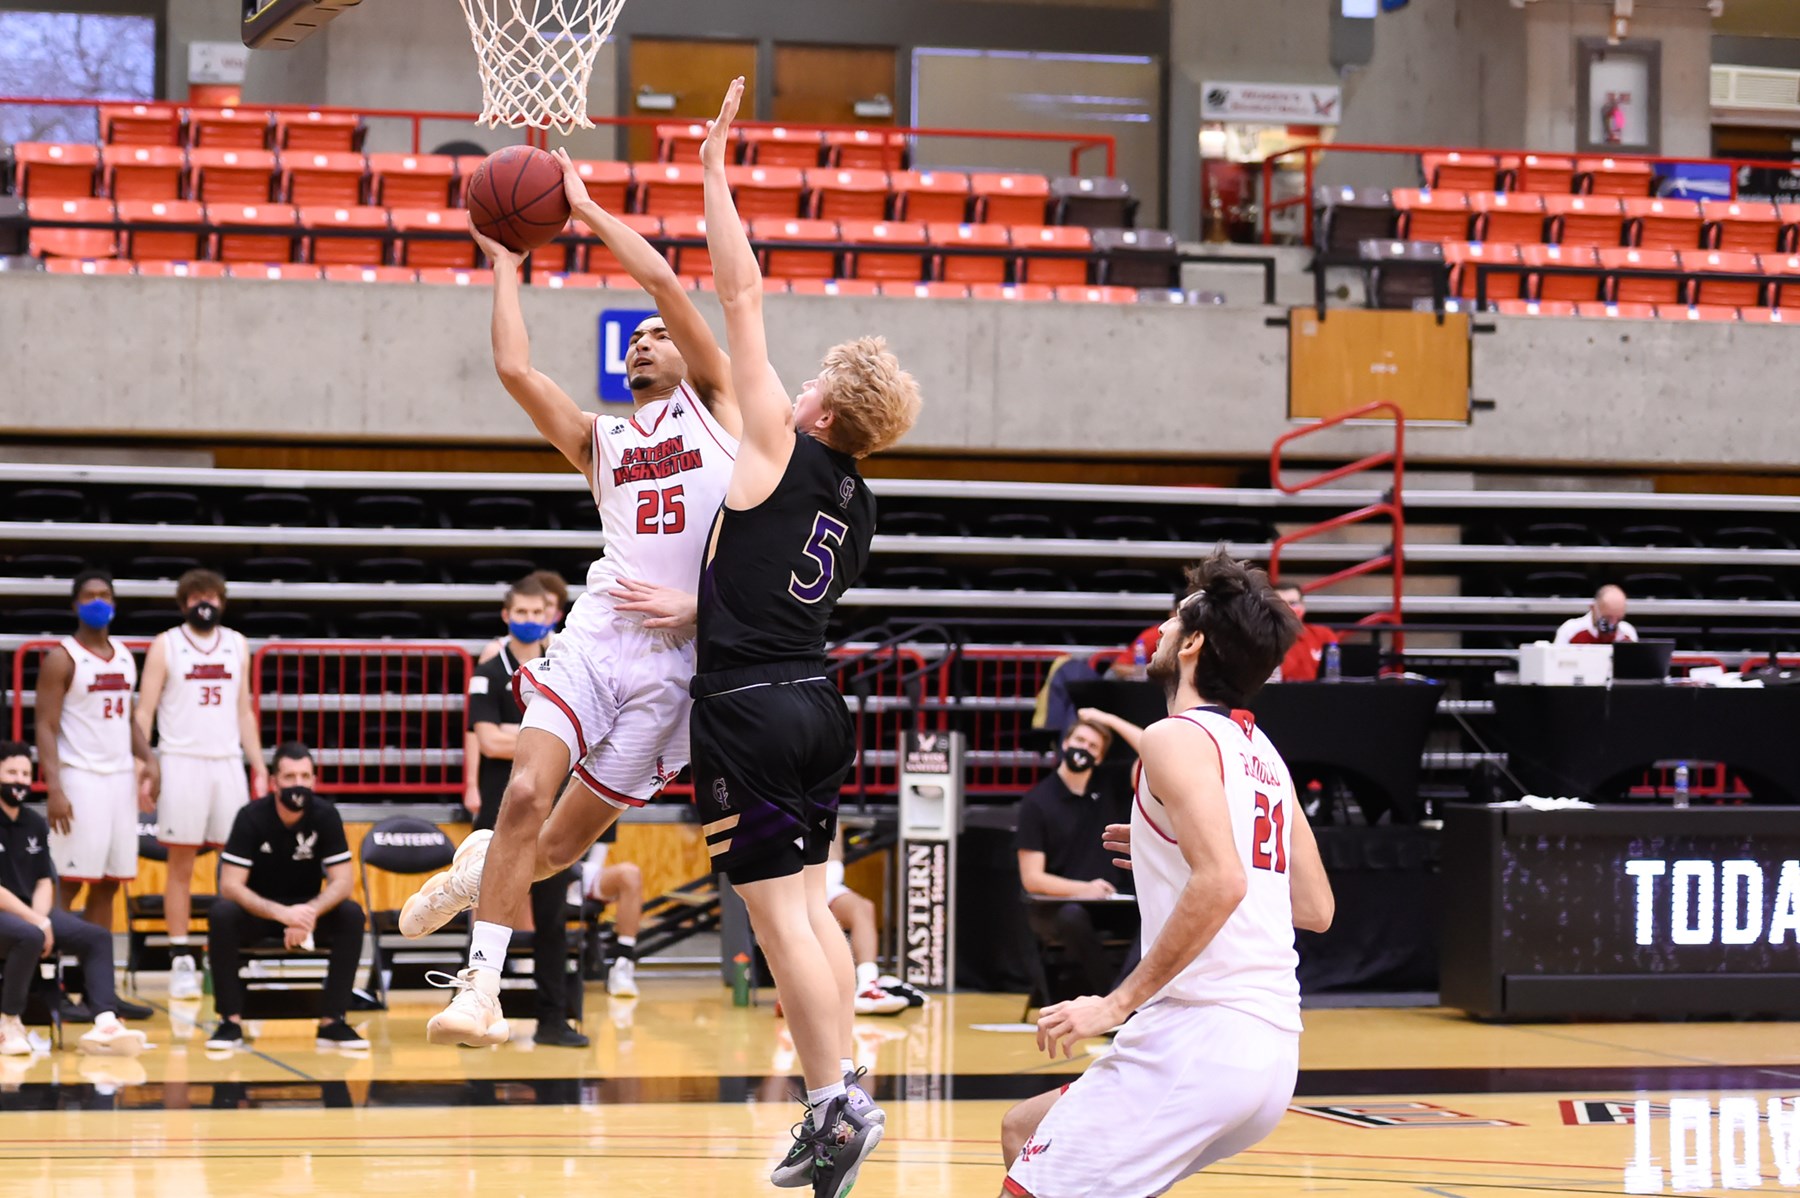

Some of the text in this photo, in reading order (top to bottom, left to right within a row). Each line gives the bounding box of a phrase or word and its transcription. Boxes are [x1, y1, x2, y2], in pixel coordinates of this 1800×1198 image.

[636, 484, 685, 534] 25
[788, 510, 849, 604] 5
[103, 698, 124, 719] 24
[199, 686, 222, 706] 35
[373, 832, 445, 847] EASTERN
[1252, 790, 1286, 874] 21
[907, 844, 931, 985] EASTERN
[1625, 860, 1800, 945] TODA
